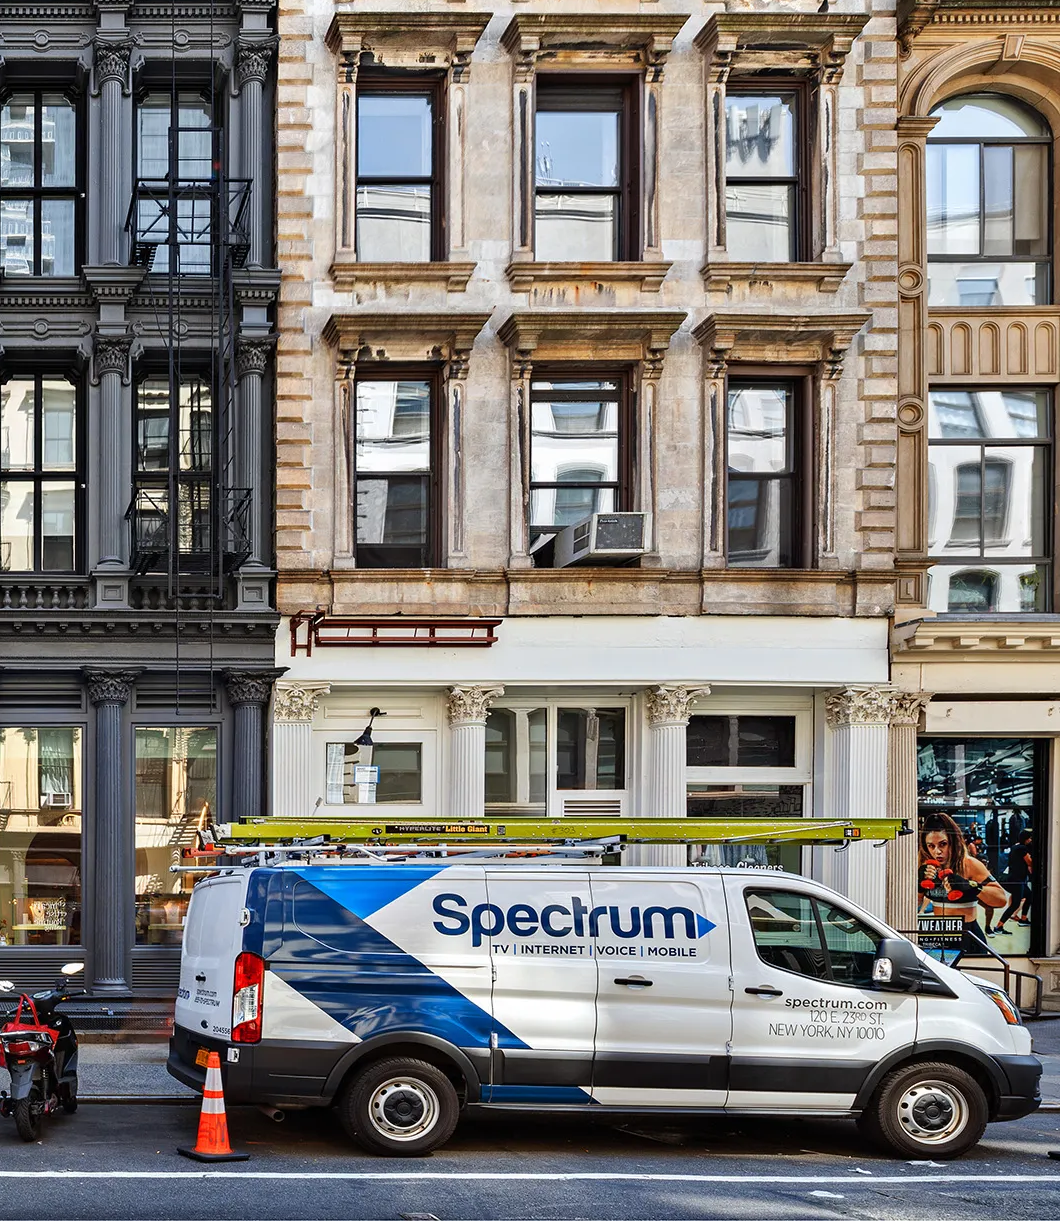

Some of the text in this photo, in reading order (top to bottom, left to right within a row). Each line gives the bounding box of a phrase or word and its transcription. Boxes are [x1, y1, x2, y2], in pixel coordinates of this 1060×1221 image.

[445, 825, 466, 833] Little
[467, 825, 488, 833] Giant
[432, 893, 697, 947] Spectrum
[492, 945, 697, 957] TV INTERNET VOICE MOBILE
[785, 997, 887, 1010] spectrum.com
[809, 1010, 884, 1026] 120 E. 23RD ST.
[769, 1023, 885, 1041] NEW YORK, NY 10010
